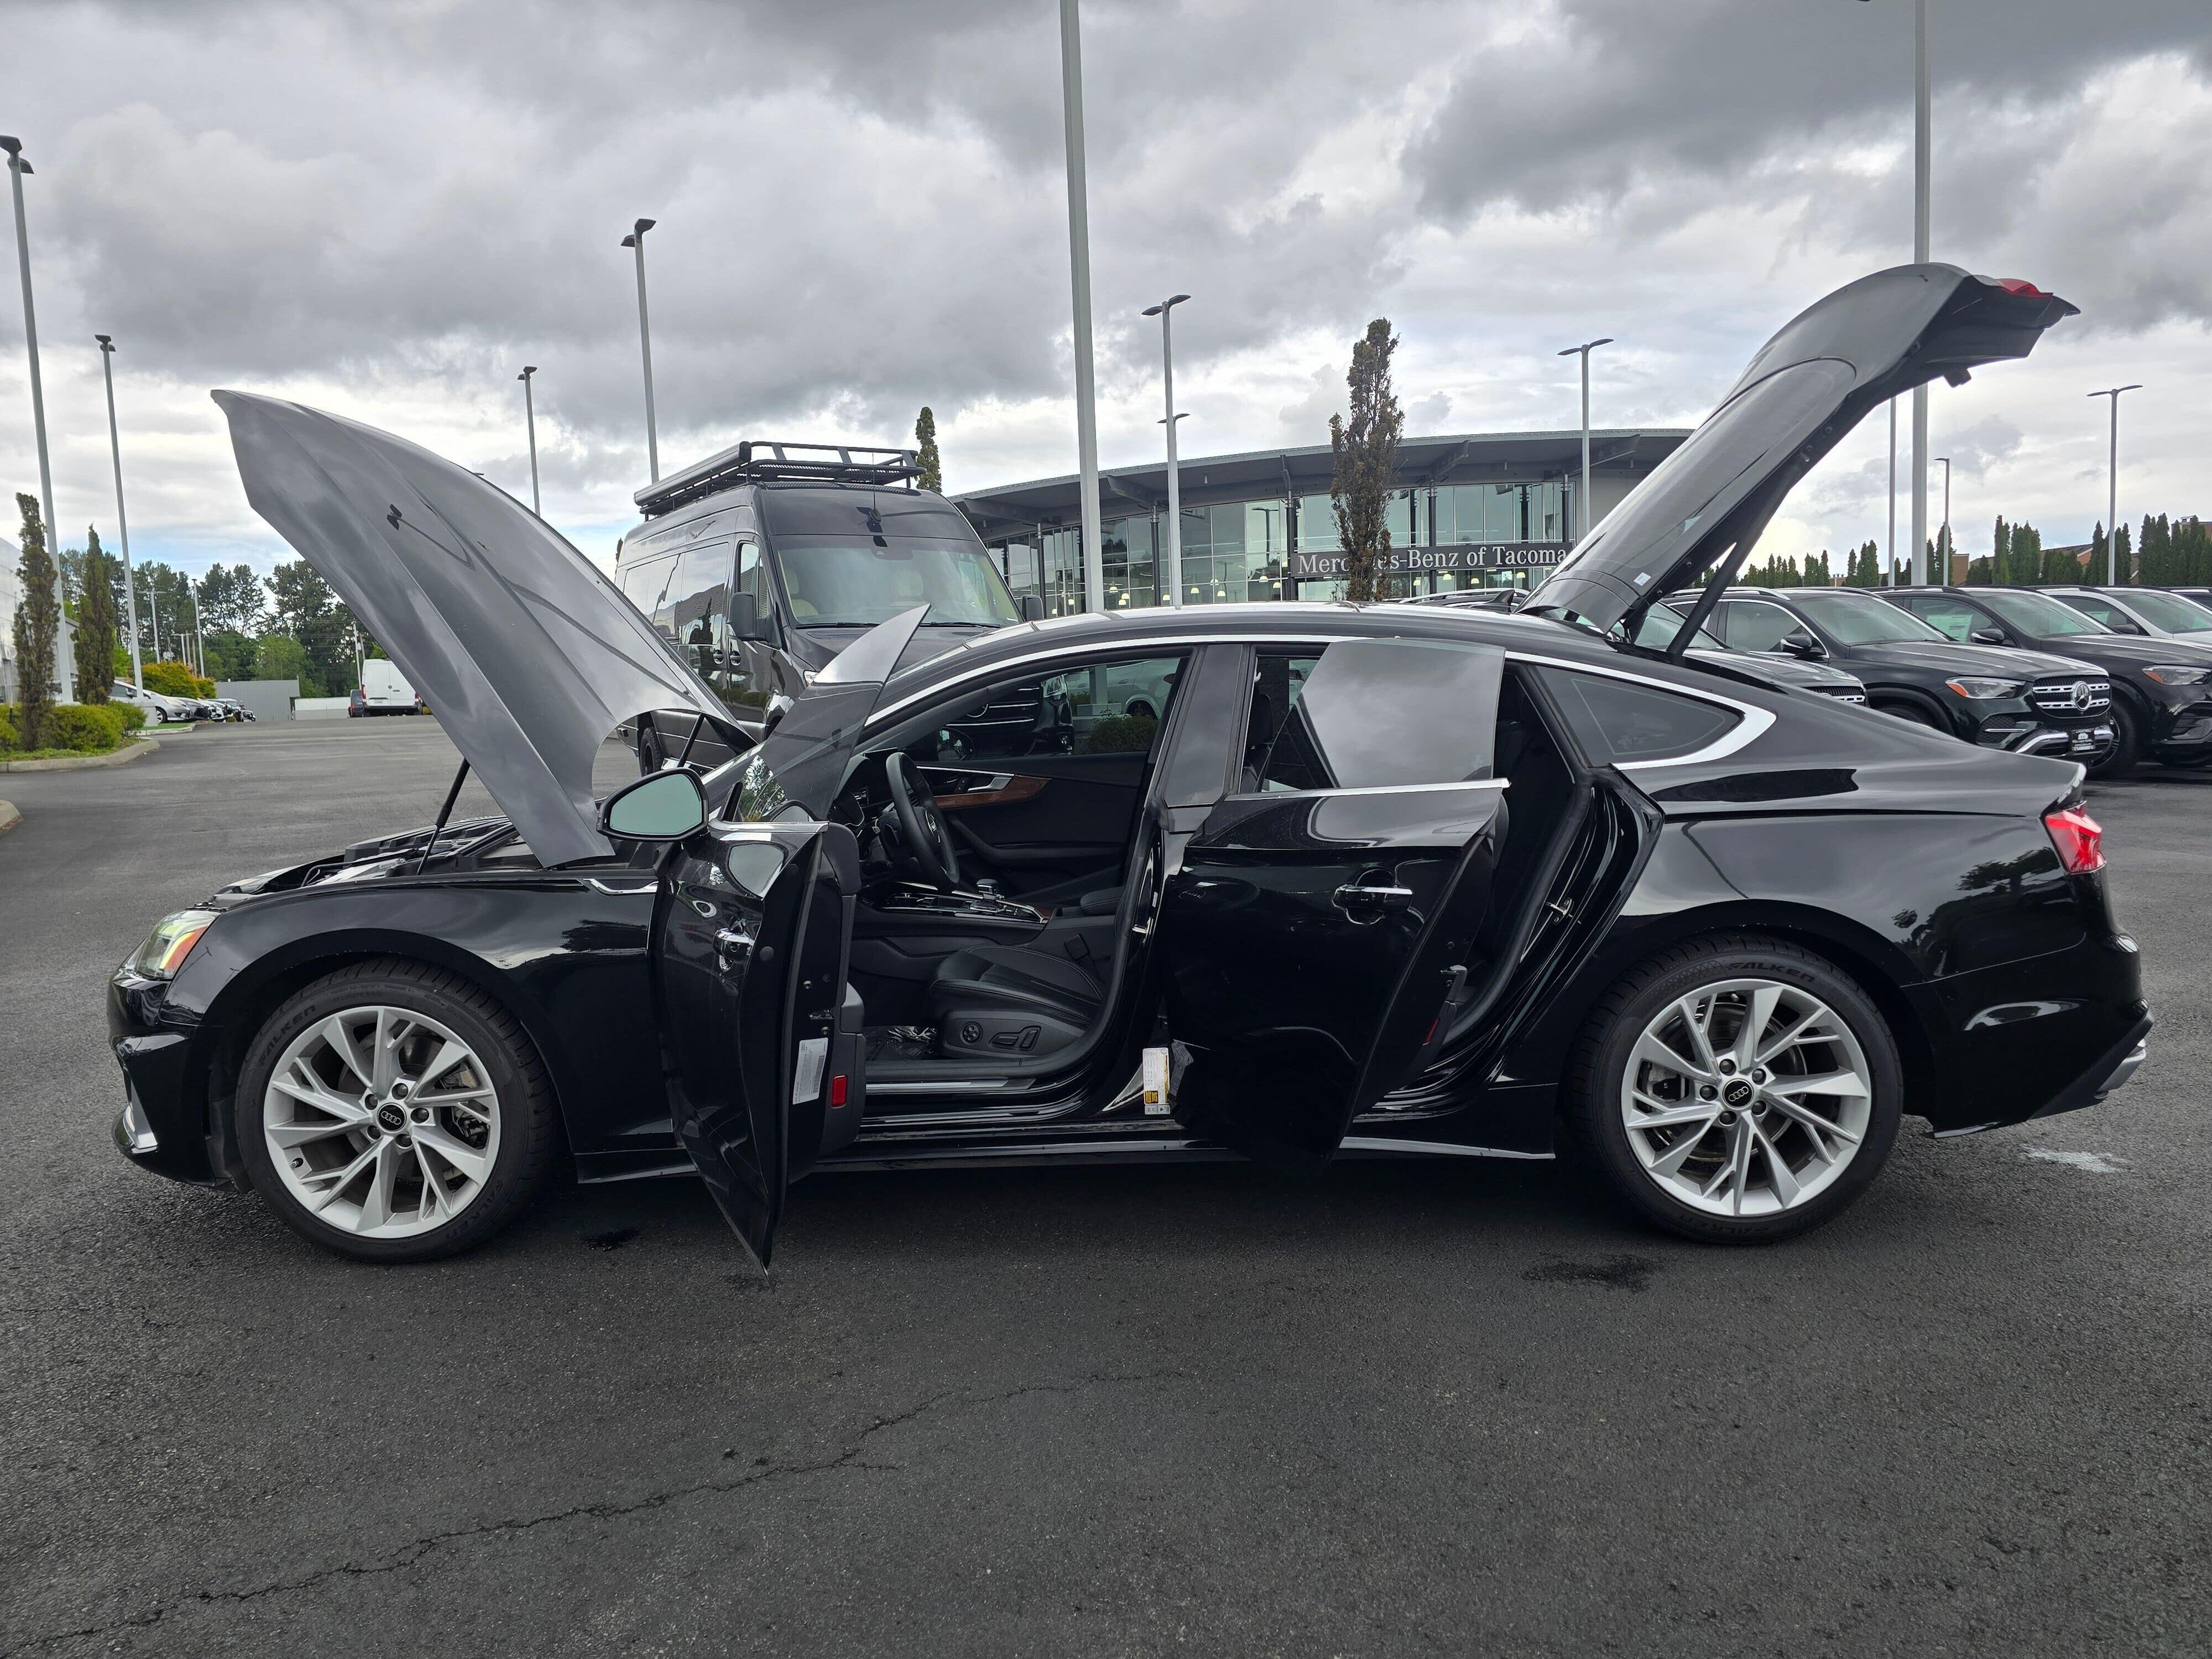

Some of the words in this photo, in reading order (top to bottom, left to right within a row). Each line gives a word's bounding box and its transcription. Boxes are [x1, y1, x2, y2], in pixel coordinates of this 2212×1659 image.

[1297, 549, 1459, 574] Merces-Benz
[1466, 546, 1487, 566] of
[1492, 546, 1567, 565] Tacoma
[1726, 961, 1815, 983] FALKEN
[257, 1004, 316, 1066] FALKEN
